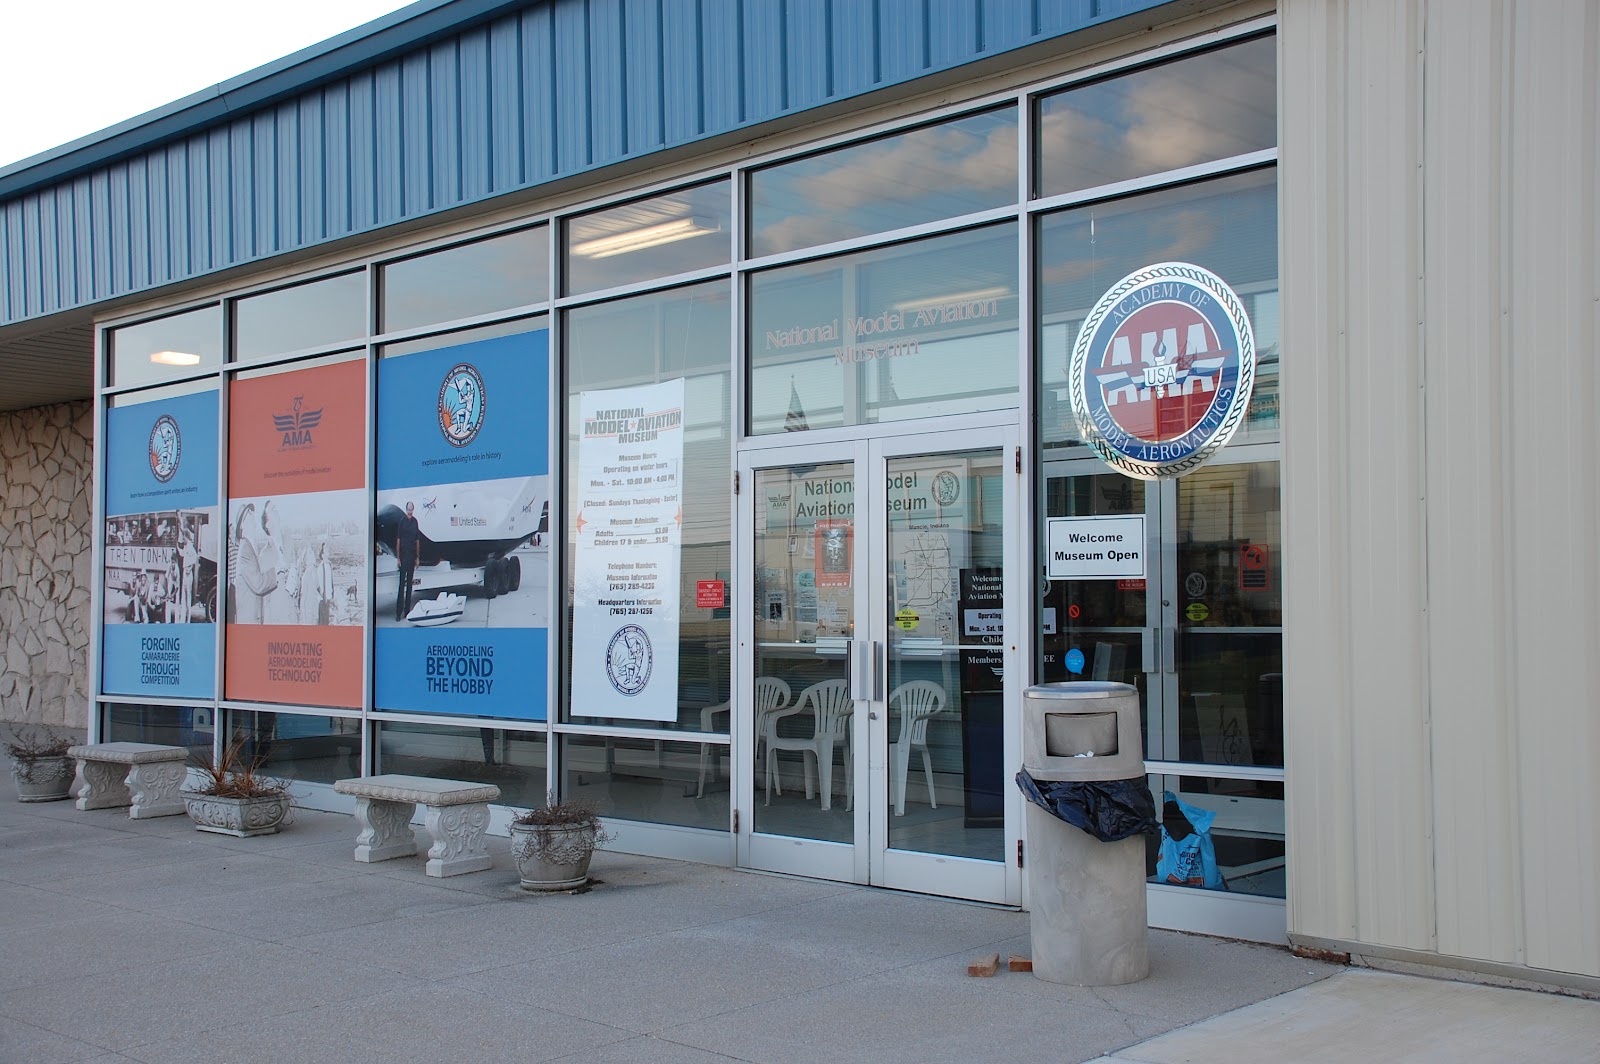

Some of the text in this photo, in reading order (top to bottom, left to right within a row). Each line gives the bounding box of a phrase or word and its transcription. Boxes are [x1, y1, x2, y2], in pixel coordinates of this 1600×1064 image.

[1112, 284, 1210, 324] ACADEMY OF
[766, 298, 998, 350] National Model Aviation
[834, 338, 919, 366] Museum
[1148, 370, 1175, 385] USA
[596, 408, 644, 420] NATIONAL
[585, 411, 681, 434] MODEL AVIATION
[1092, 388, 1231, 460] MODEL AERONAUTICS
[282, 430, 312, 447] AMA
[619, 430, 658, 444] MUSEUM
[486, 452, 501, 460] history
[632, 497, 660, 506] Thanksgiving
[796, 502, 854, 517] Aviation
[459, 517, 487, 526] United States
[1069, 533, 1123, 543] Welcome
[1055, 550, 1139, 562] Museum Open
[610, 608, 626, 616] (765)
[141, 637, 180, 651] FORGING
[268, 642, 322, 656] INNOVATING
[427, 645, 493, 657] AEROMODELING
[141, 652, 180, 662] CAMARADERIE
[268, 656, 322, 669] AEROMODELING
[141, 663, 180, 676] THROUGH
[426, 657, 493, 677] BEYOND
[141, 675, 180, 685] COMPETITION
[268, 668, 322, 683] TECHNOLOGY
[427, 677, 493, 694] THE HOBBY
